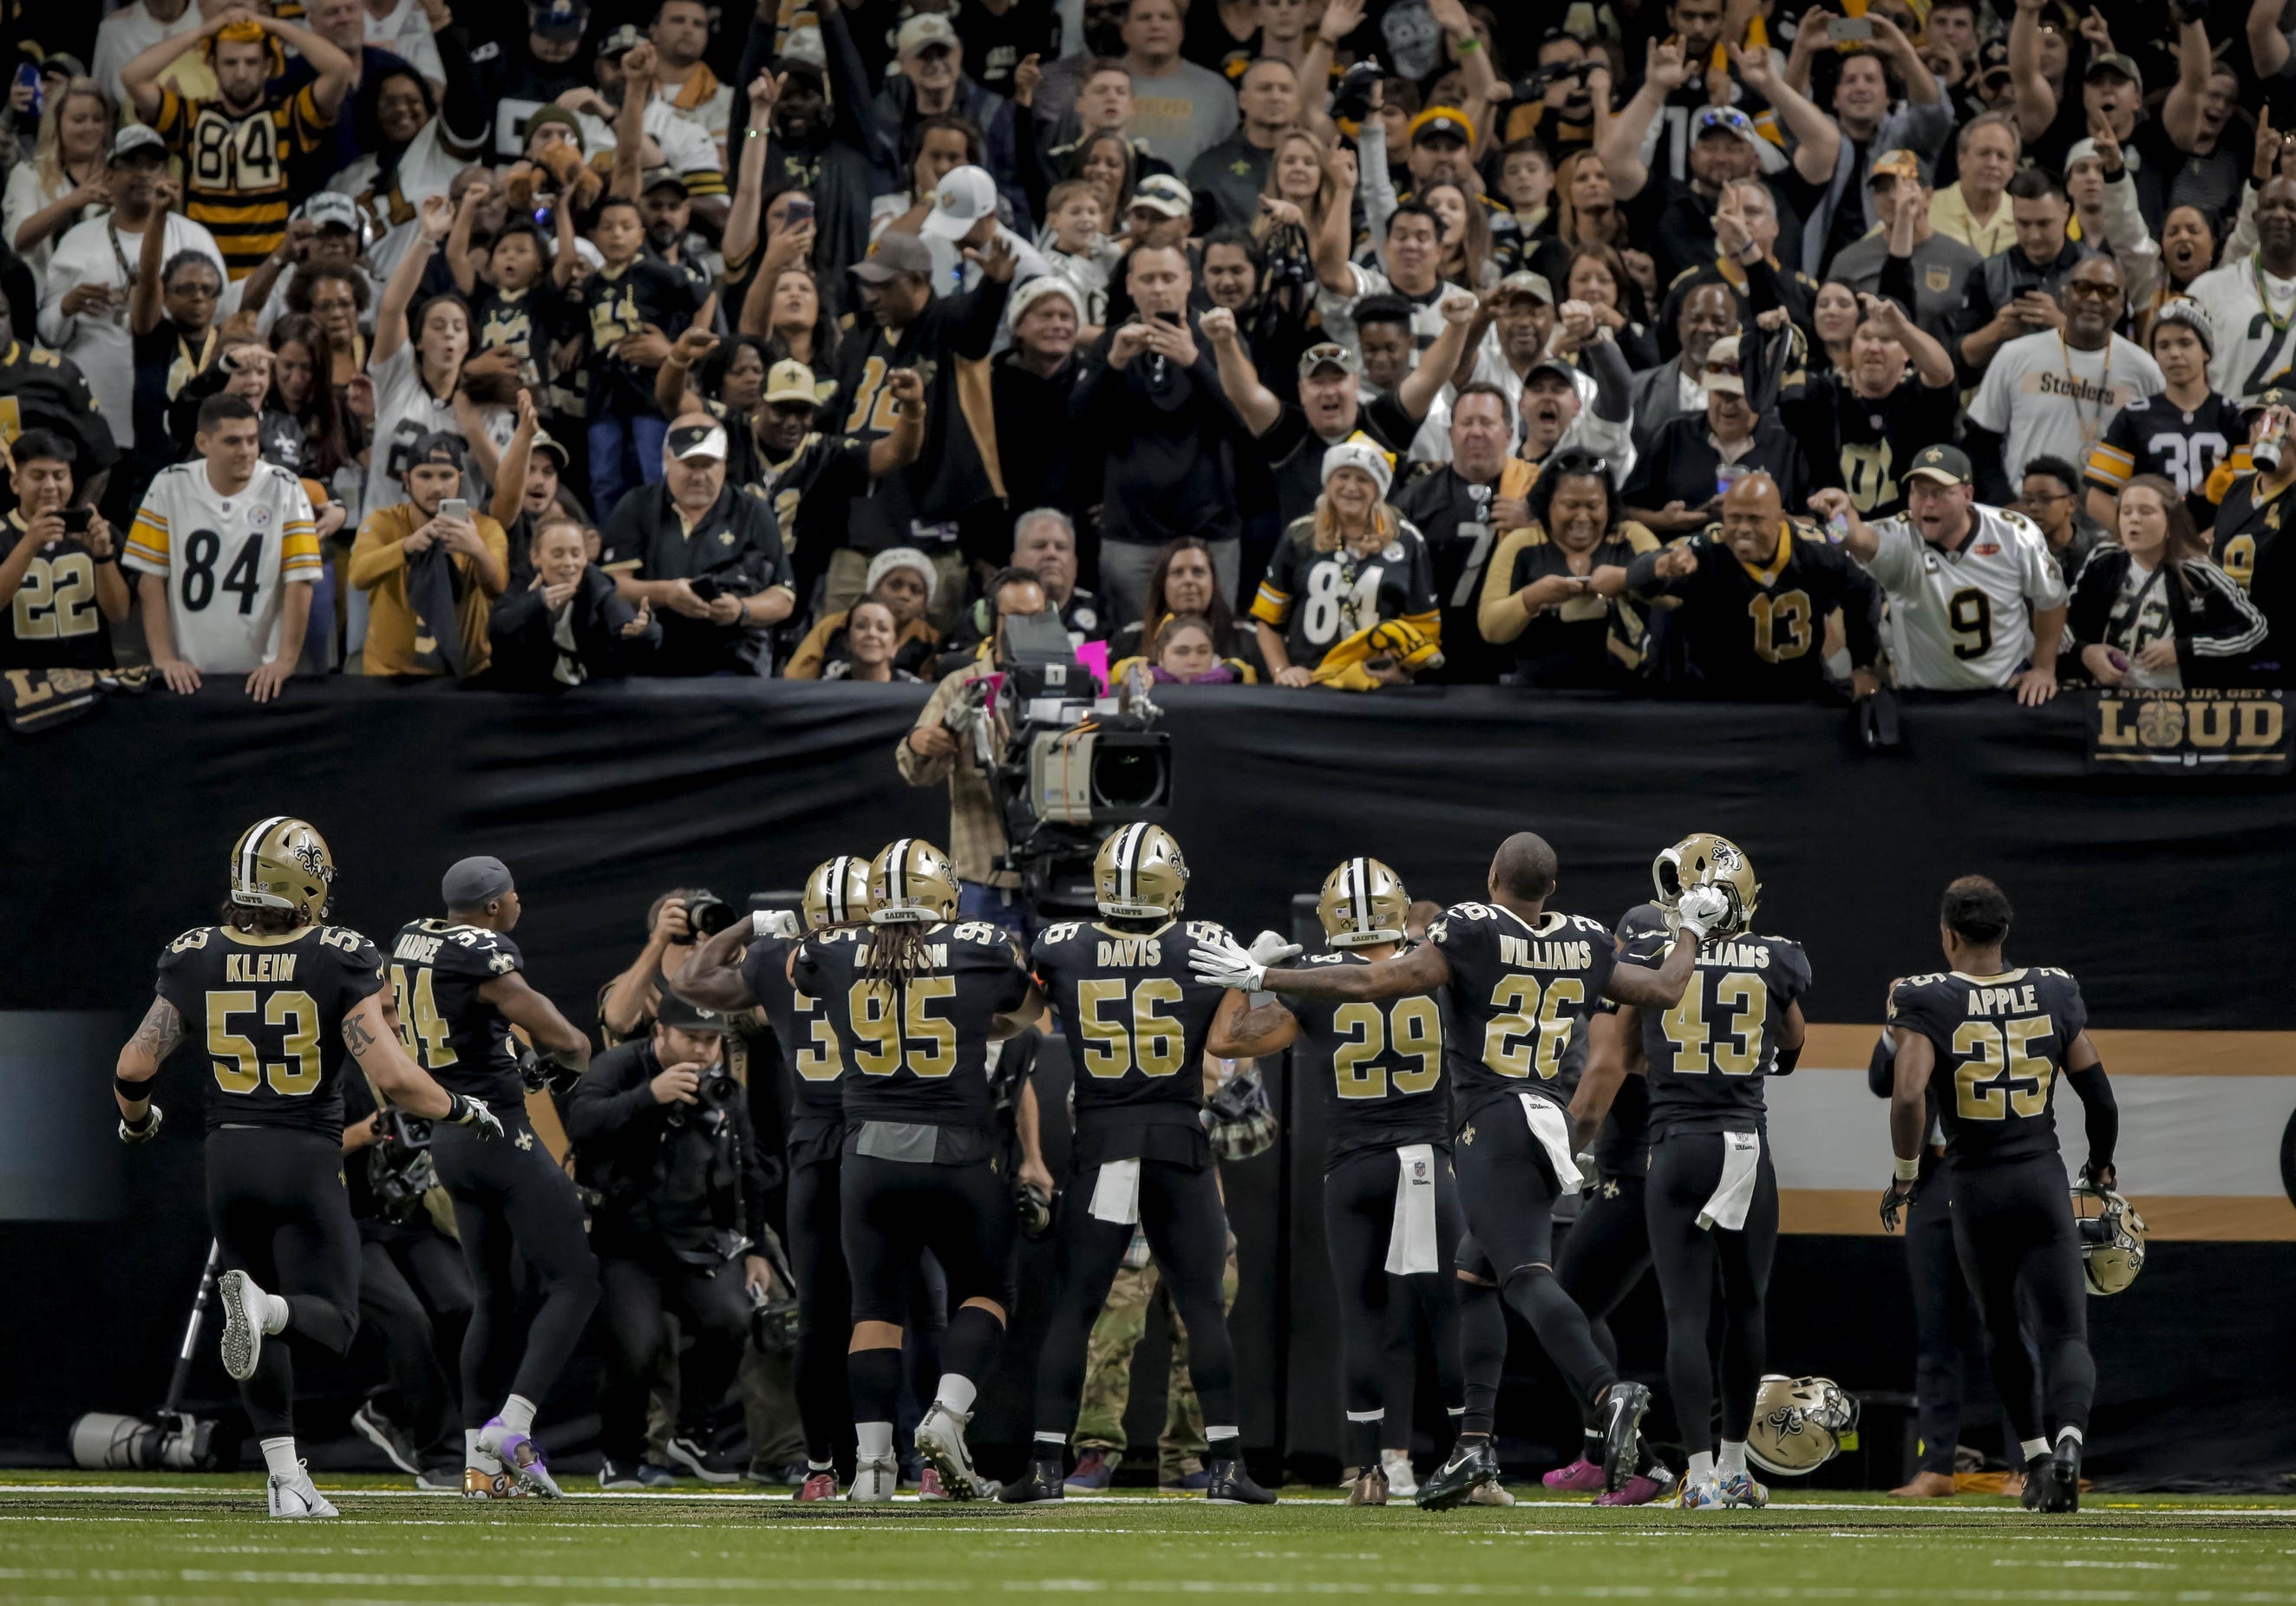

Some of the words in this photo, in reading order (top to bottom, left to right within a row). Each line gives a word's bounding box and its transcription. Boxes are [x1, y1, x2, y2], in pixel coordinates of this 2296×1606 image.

[193, 110, 282, 190] 84
[2040, 370, 2116, 405] Steelers
[2148, 432, 2227, 498] 30
[13, 552, 99, 639] 22
[180, 528, 265, 616] 84
[1450, 522, 1495, 606] 7
[1749, 589, 1813, 664] 13
[1950, 587, 1992, 660] 9
[2097, 700, 2284, 747] LOUD
[884, 911, 917, 920] SAINTS
[1110, 906, 1142, 916] SAINTS
[1351, 934, 1380, 943] SAINTS
[226, 953, 298, 983] KLEIN
[854, 943, 948, 969] DSON
[1097, 938, 1161, 968] DAVIS
[1499, 934, 1593, 970] WILLIAMS
[1665, 939, 1770, 969] LIAMS
[390, 963, 459, 1069] 34
[848, 976, 957, 1078] 95
[1077, 978, 1186, 1079] 56
[1482, 973, 1586, 1080] 26
[1661, 969, 1768, 1076] 43
[1967, 984, 2038, 1016] APPLE
[205, 989, 322, 1096] 53
[1333, 995, 1442, 1099] 29
[1952, 1014, 2055, 1120] 25
